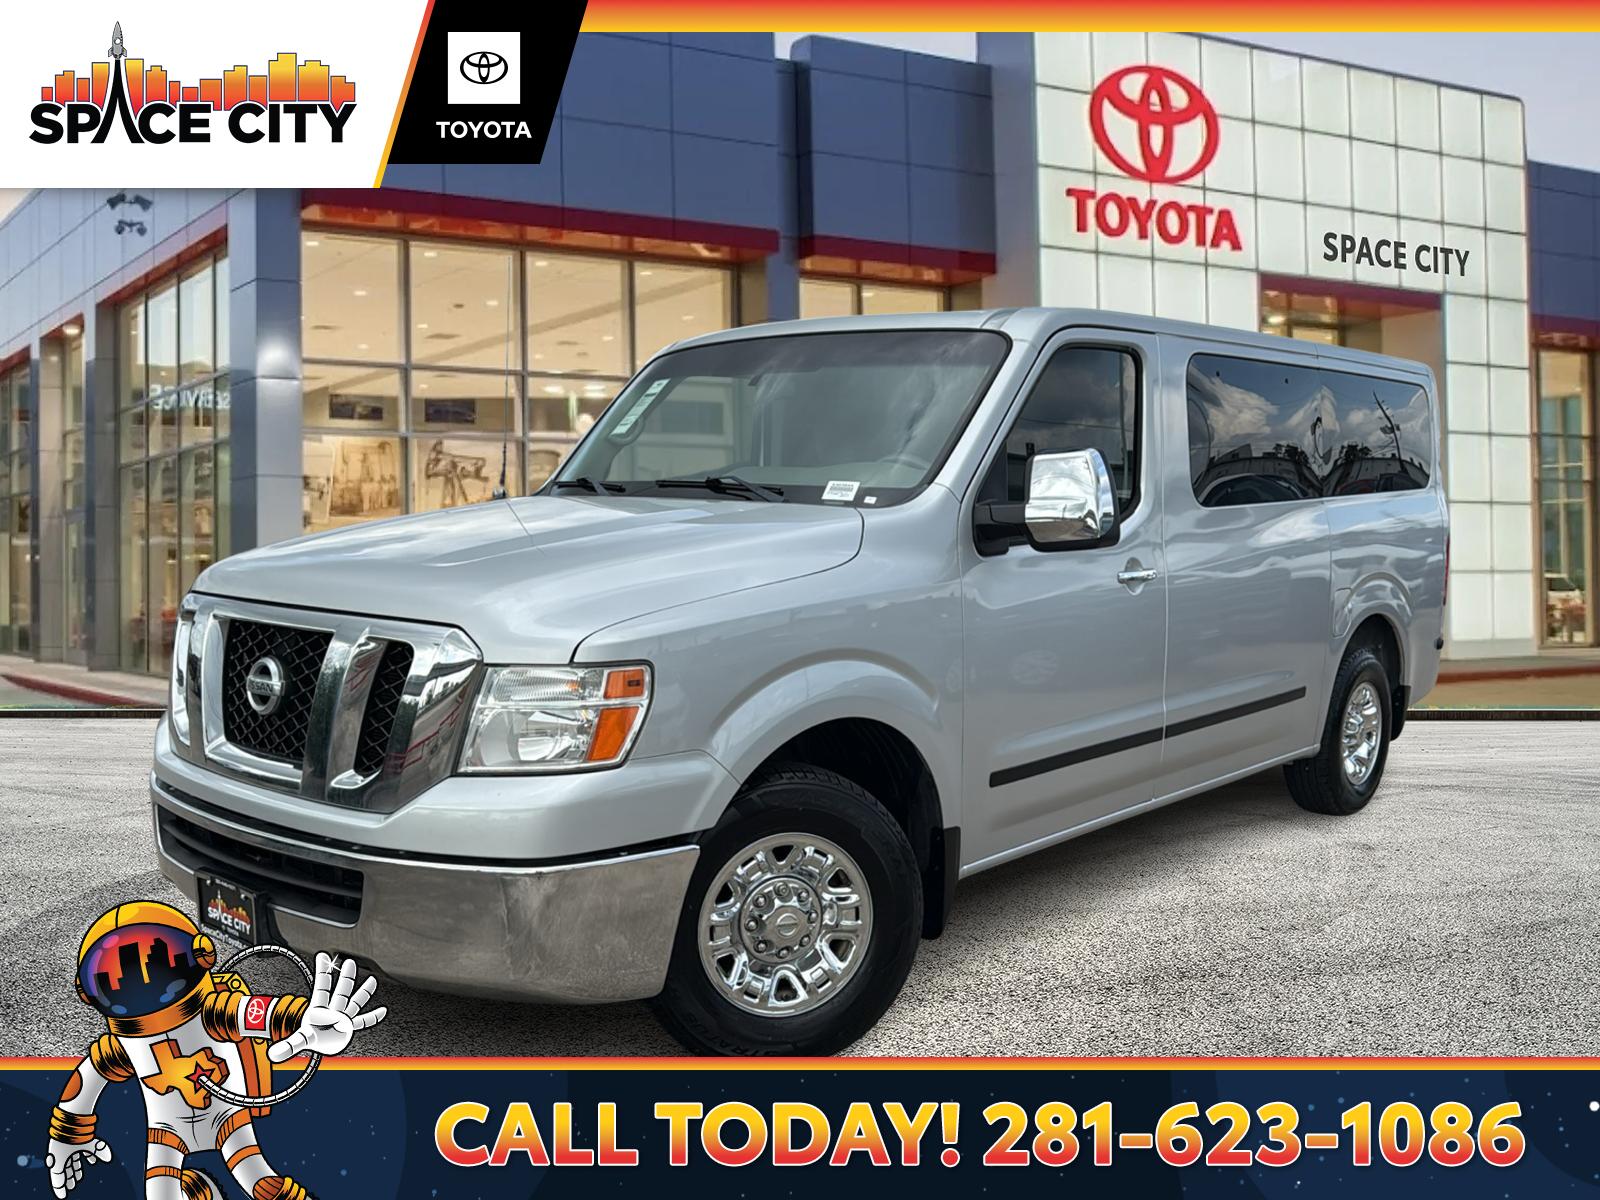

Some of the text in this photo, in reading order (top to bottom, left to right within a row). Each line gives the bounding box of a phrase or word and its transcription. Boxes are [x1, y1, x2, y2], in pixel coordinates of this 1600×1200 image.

[1065, 185, 1243, 252] TOYOTA
[1322, 232, 1470, 277] SPACE CITY
[207, 904, 233, 928] SPACE
[234, 917, 251, 936] CITY
